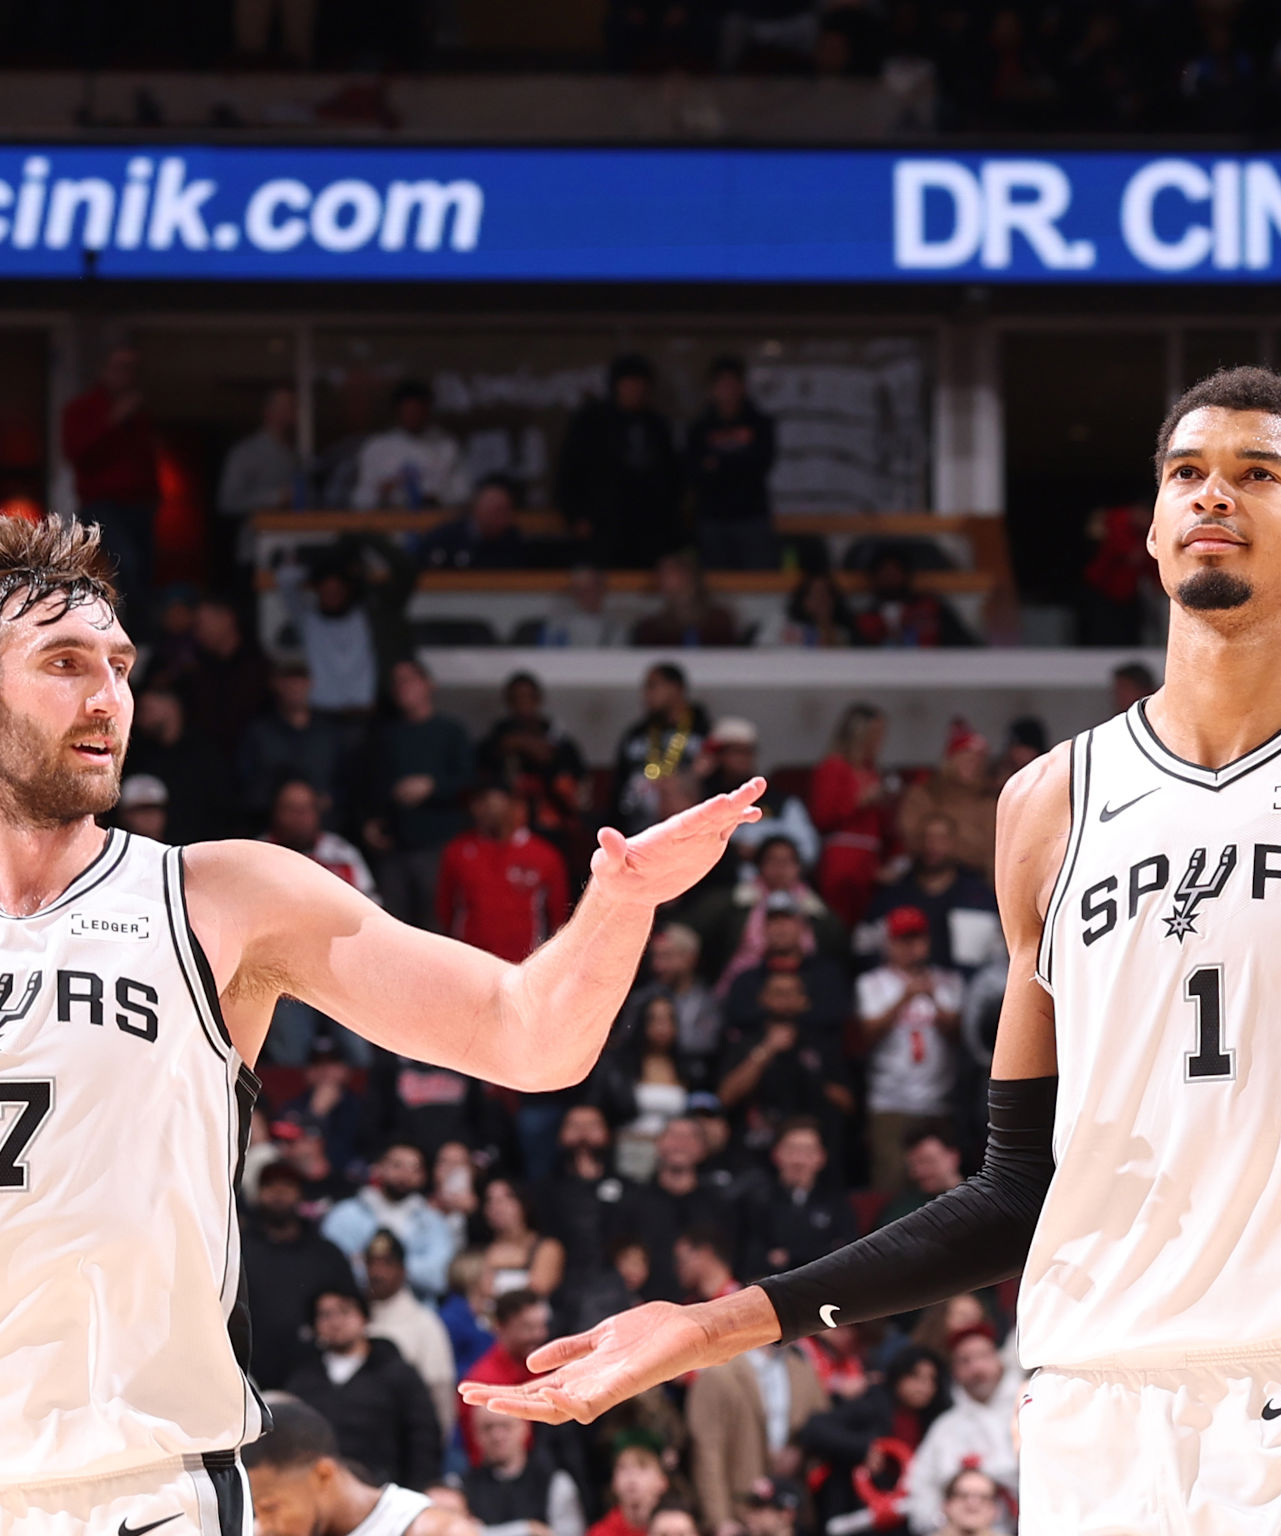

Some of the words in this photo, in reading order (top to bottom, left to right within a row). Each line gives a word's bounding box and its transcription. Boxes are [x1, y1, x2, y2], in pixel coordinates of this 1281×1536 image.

[893, 158, 1097, 271] DR.
[81, 918, 139, 934] LEDGER
[1184, 962, 1237, 1084] 1
